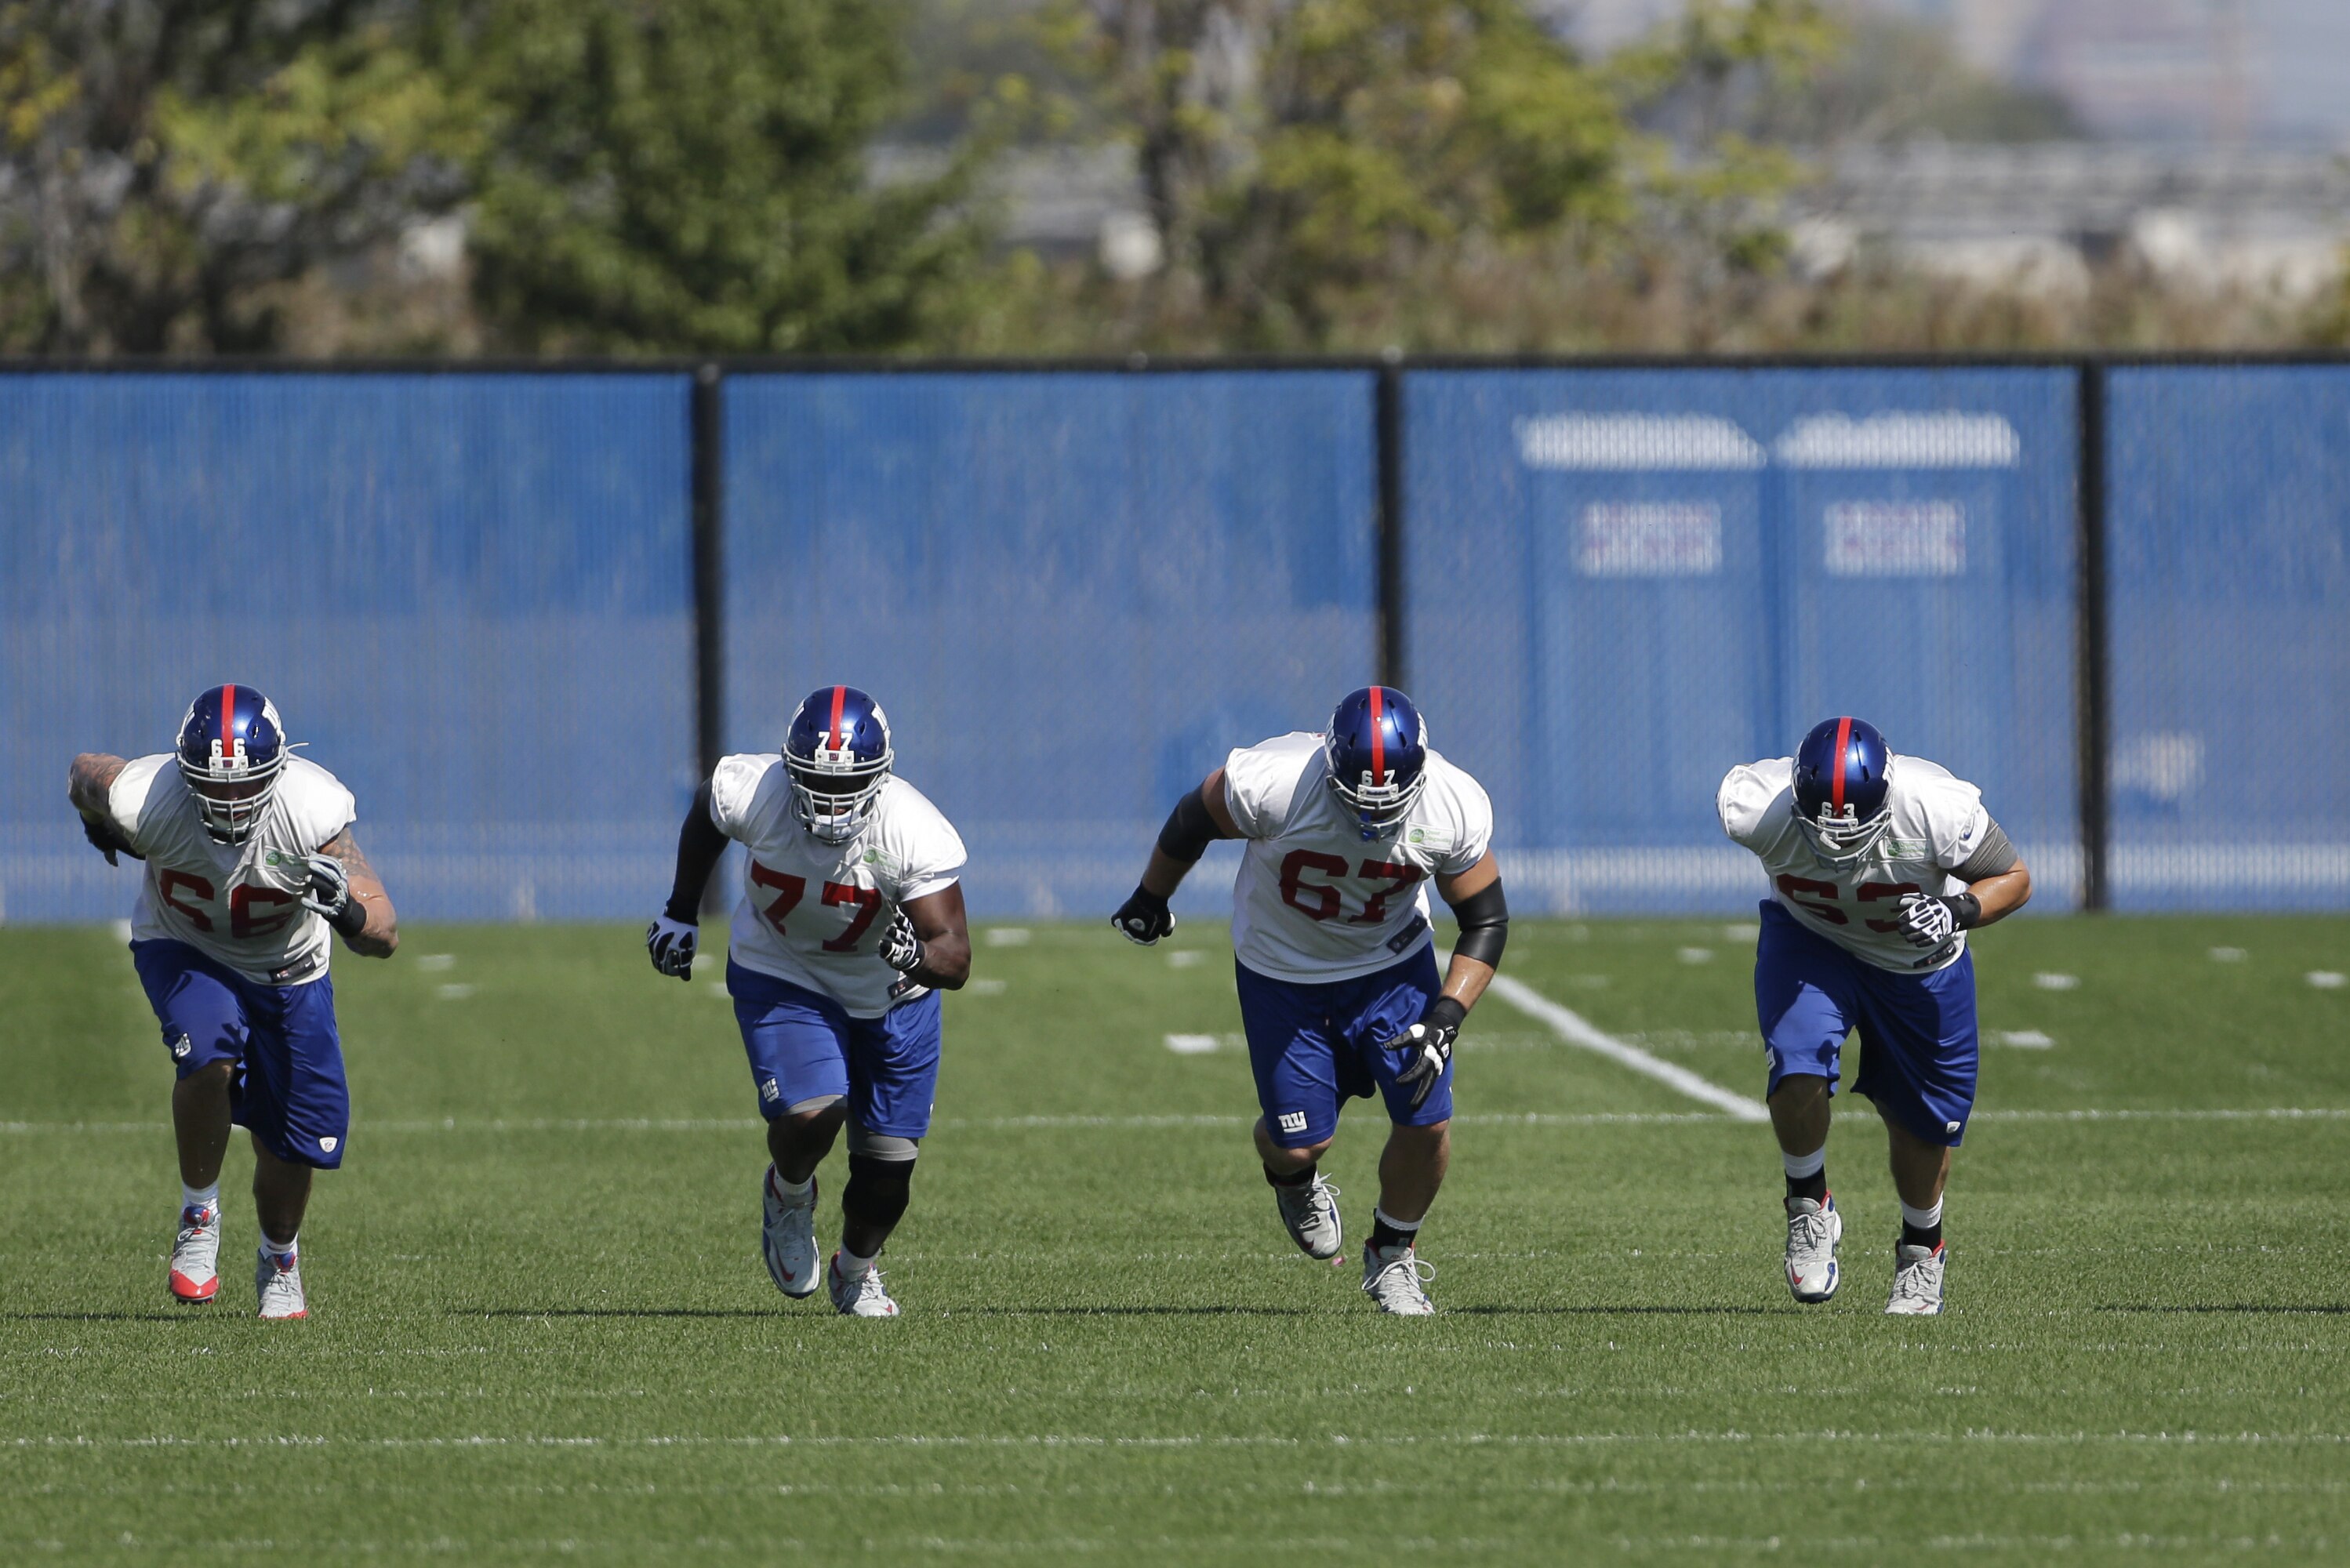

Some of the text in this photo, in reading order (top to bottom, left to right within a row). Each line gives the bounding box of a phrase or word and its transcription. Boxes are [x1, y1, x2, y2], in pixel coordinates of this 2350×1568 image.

[212, 739, 245, 757] 66
[818, 731, 852, 750] 77
[1361, 770, 1395, 786] 67
[1822, 802, 1855, 818] 63
[1280, 850, 1422, 923] 67
[752, 861, 881, 952] 77
